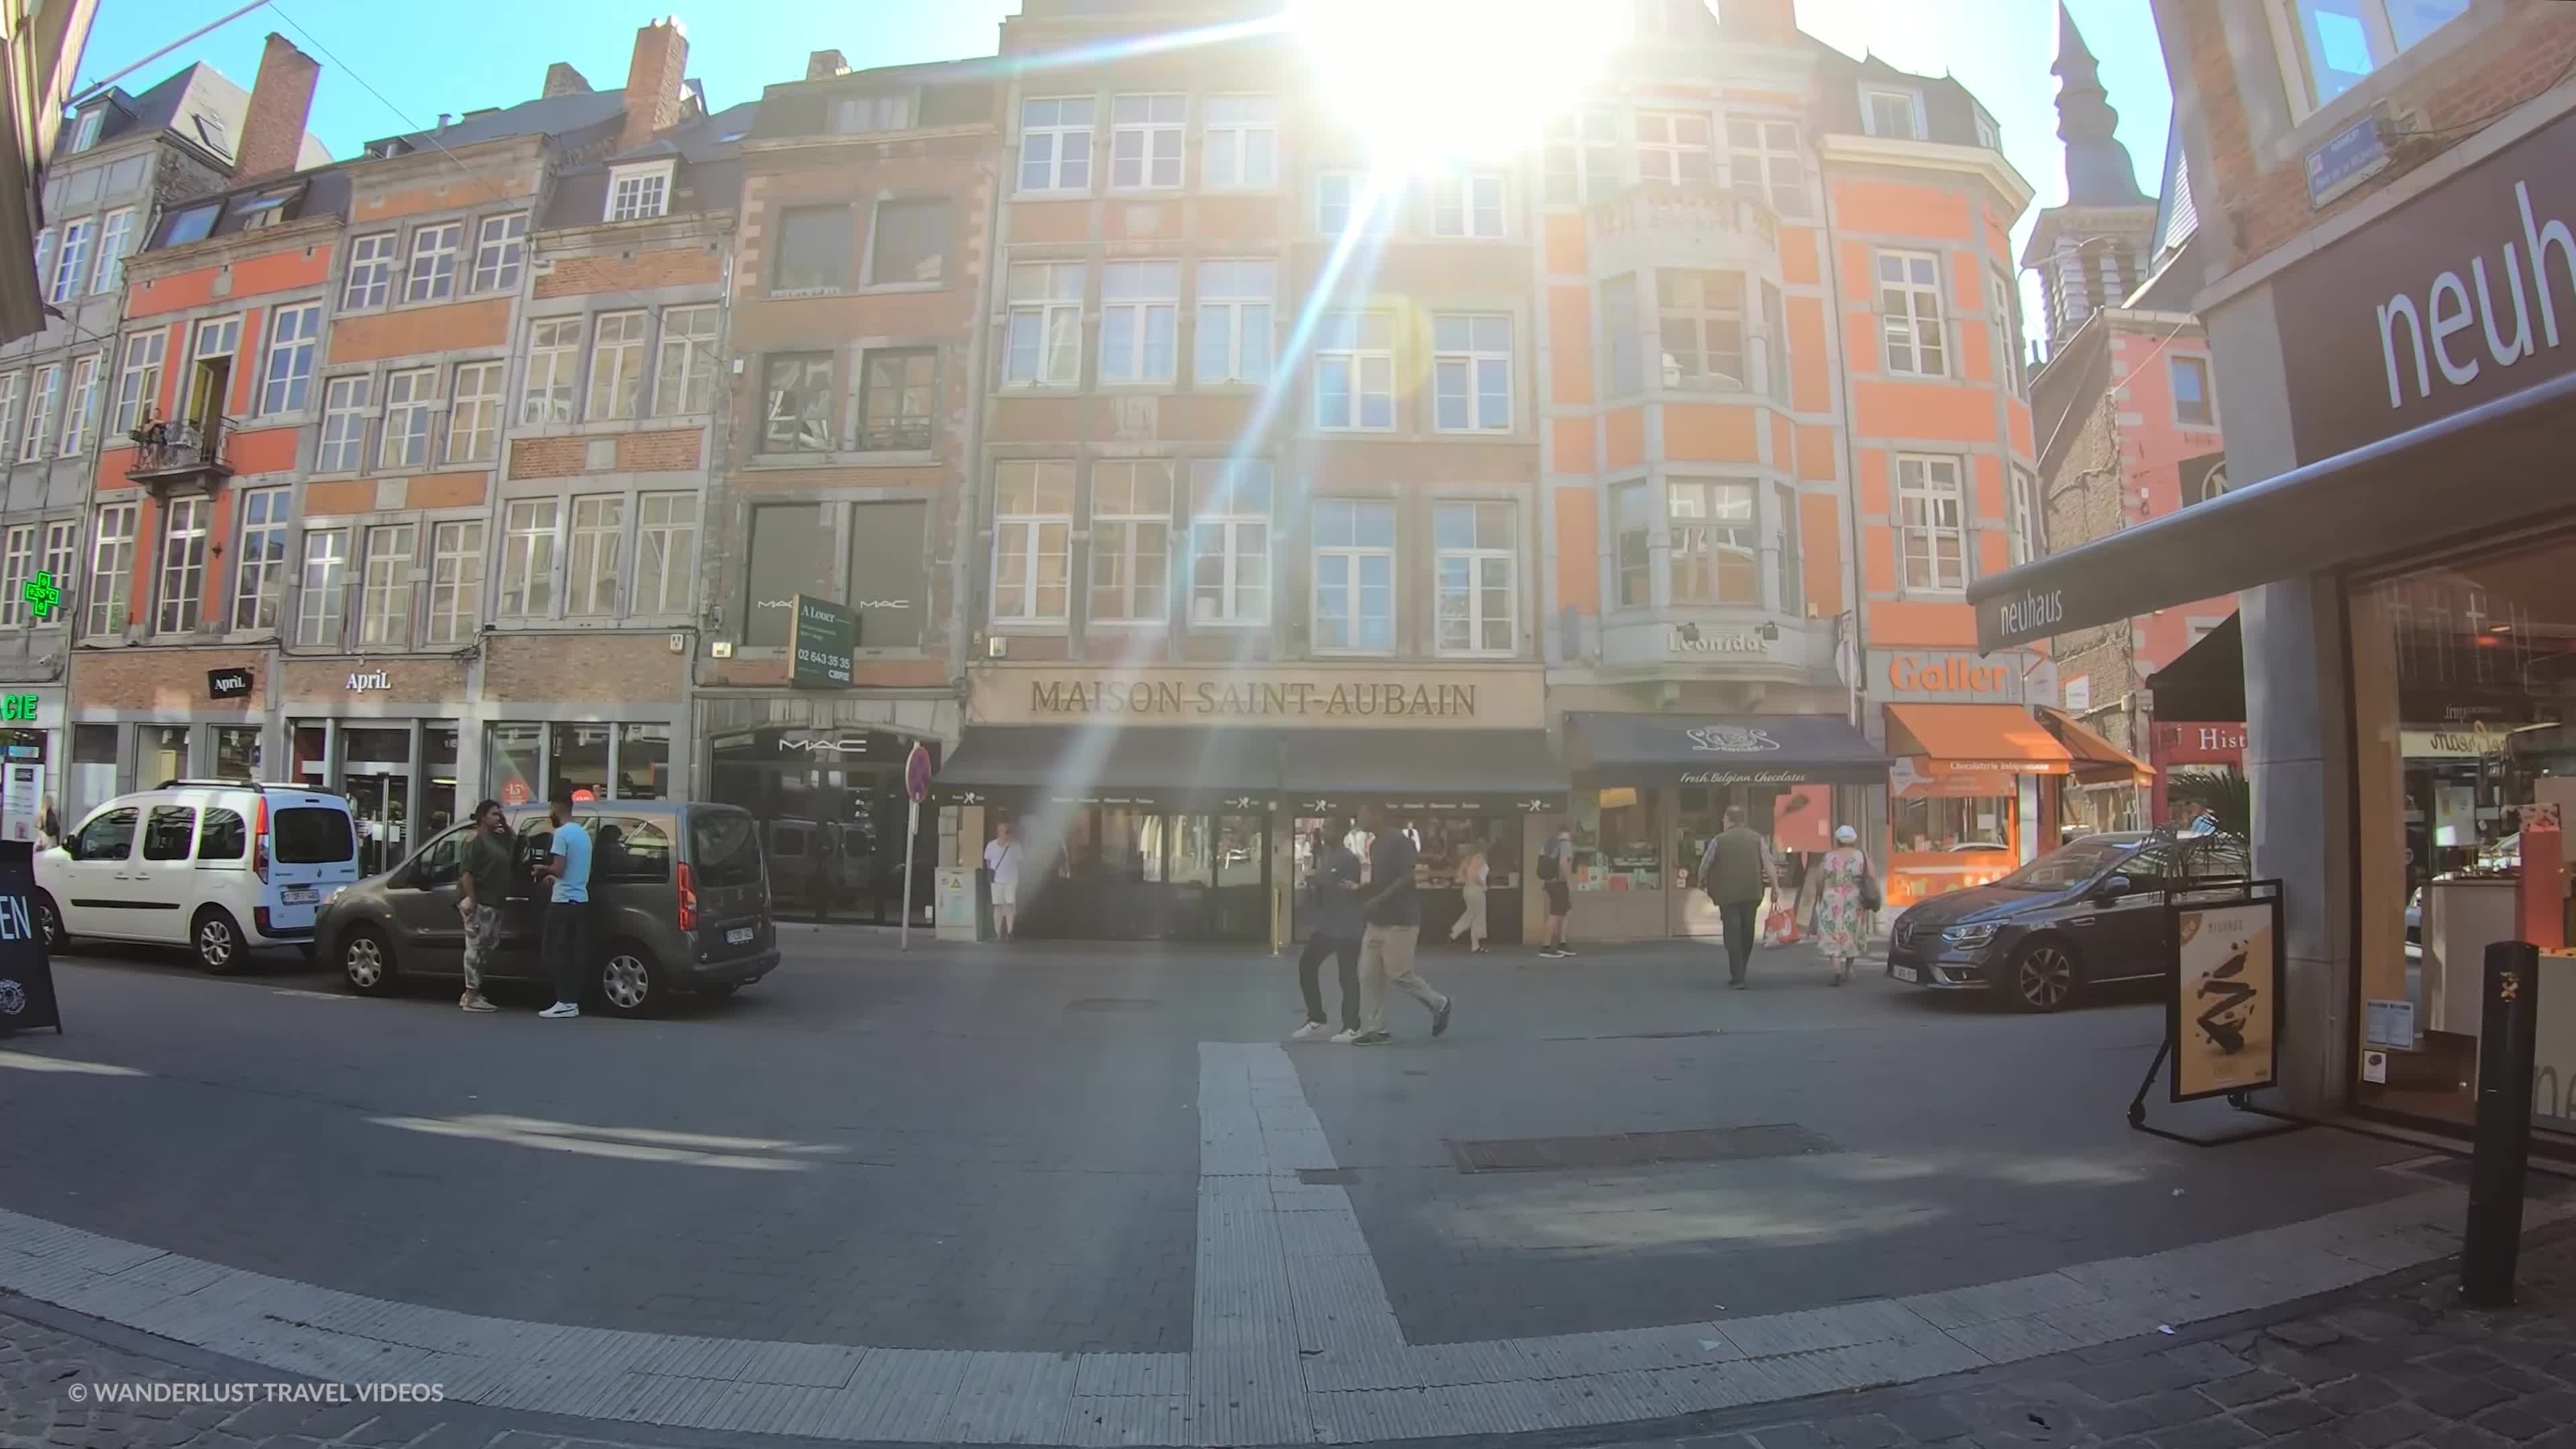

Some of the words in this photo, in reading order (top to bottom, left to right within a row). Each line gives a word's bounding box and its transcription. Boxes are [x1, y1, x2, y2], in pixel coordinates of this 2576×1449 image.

[2377, 180, 2576, 409] neuh
[810, 606, 835, 623] Louer
[2000, 589, 2063, 635] neuhaus
[1667, 633, 1768, 654] Leonidas
[798, 649, 809, 661] 02
[810, 651, 826, 664] 643
[827, 655, 838, 666] 35
[839, 657, 850, 669] 35
[1889, 654, 2008, 692] Galler
[0, 694, 38, 720] CIE
[1030, 680, 1183, 713] MAISON
[1197, 681, 1476, 716] SAINT-AUBAIN
[2199, 728, 2245, 750] Hist
[1680, 772, 1708, 783] Fresh
[1711, 771, 1750, 786] Belgian
[1754, 769, 1806, 783] Chocolates
[0, 896, 32, 939] EN
